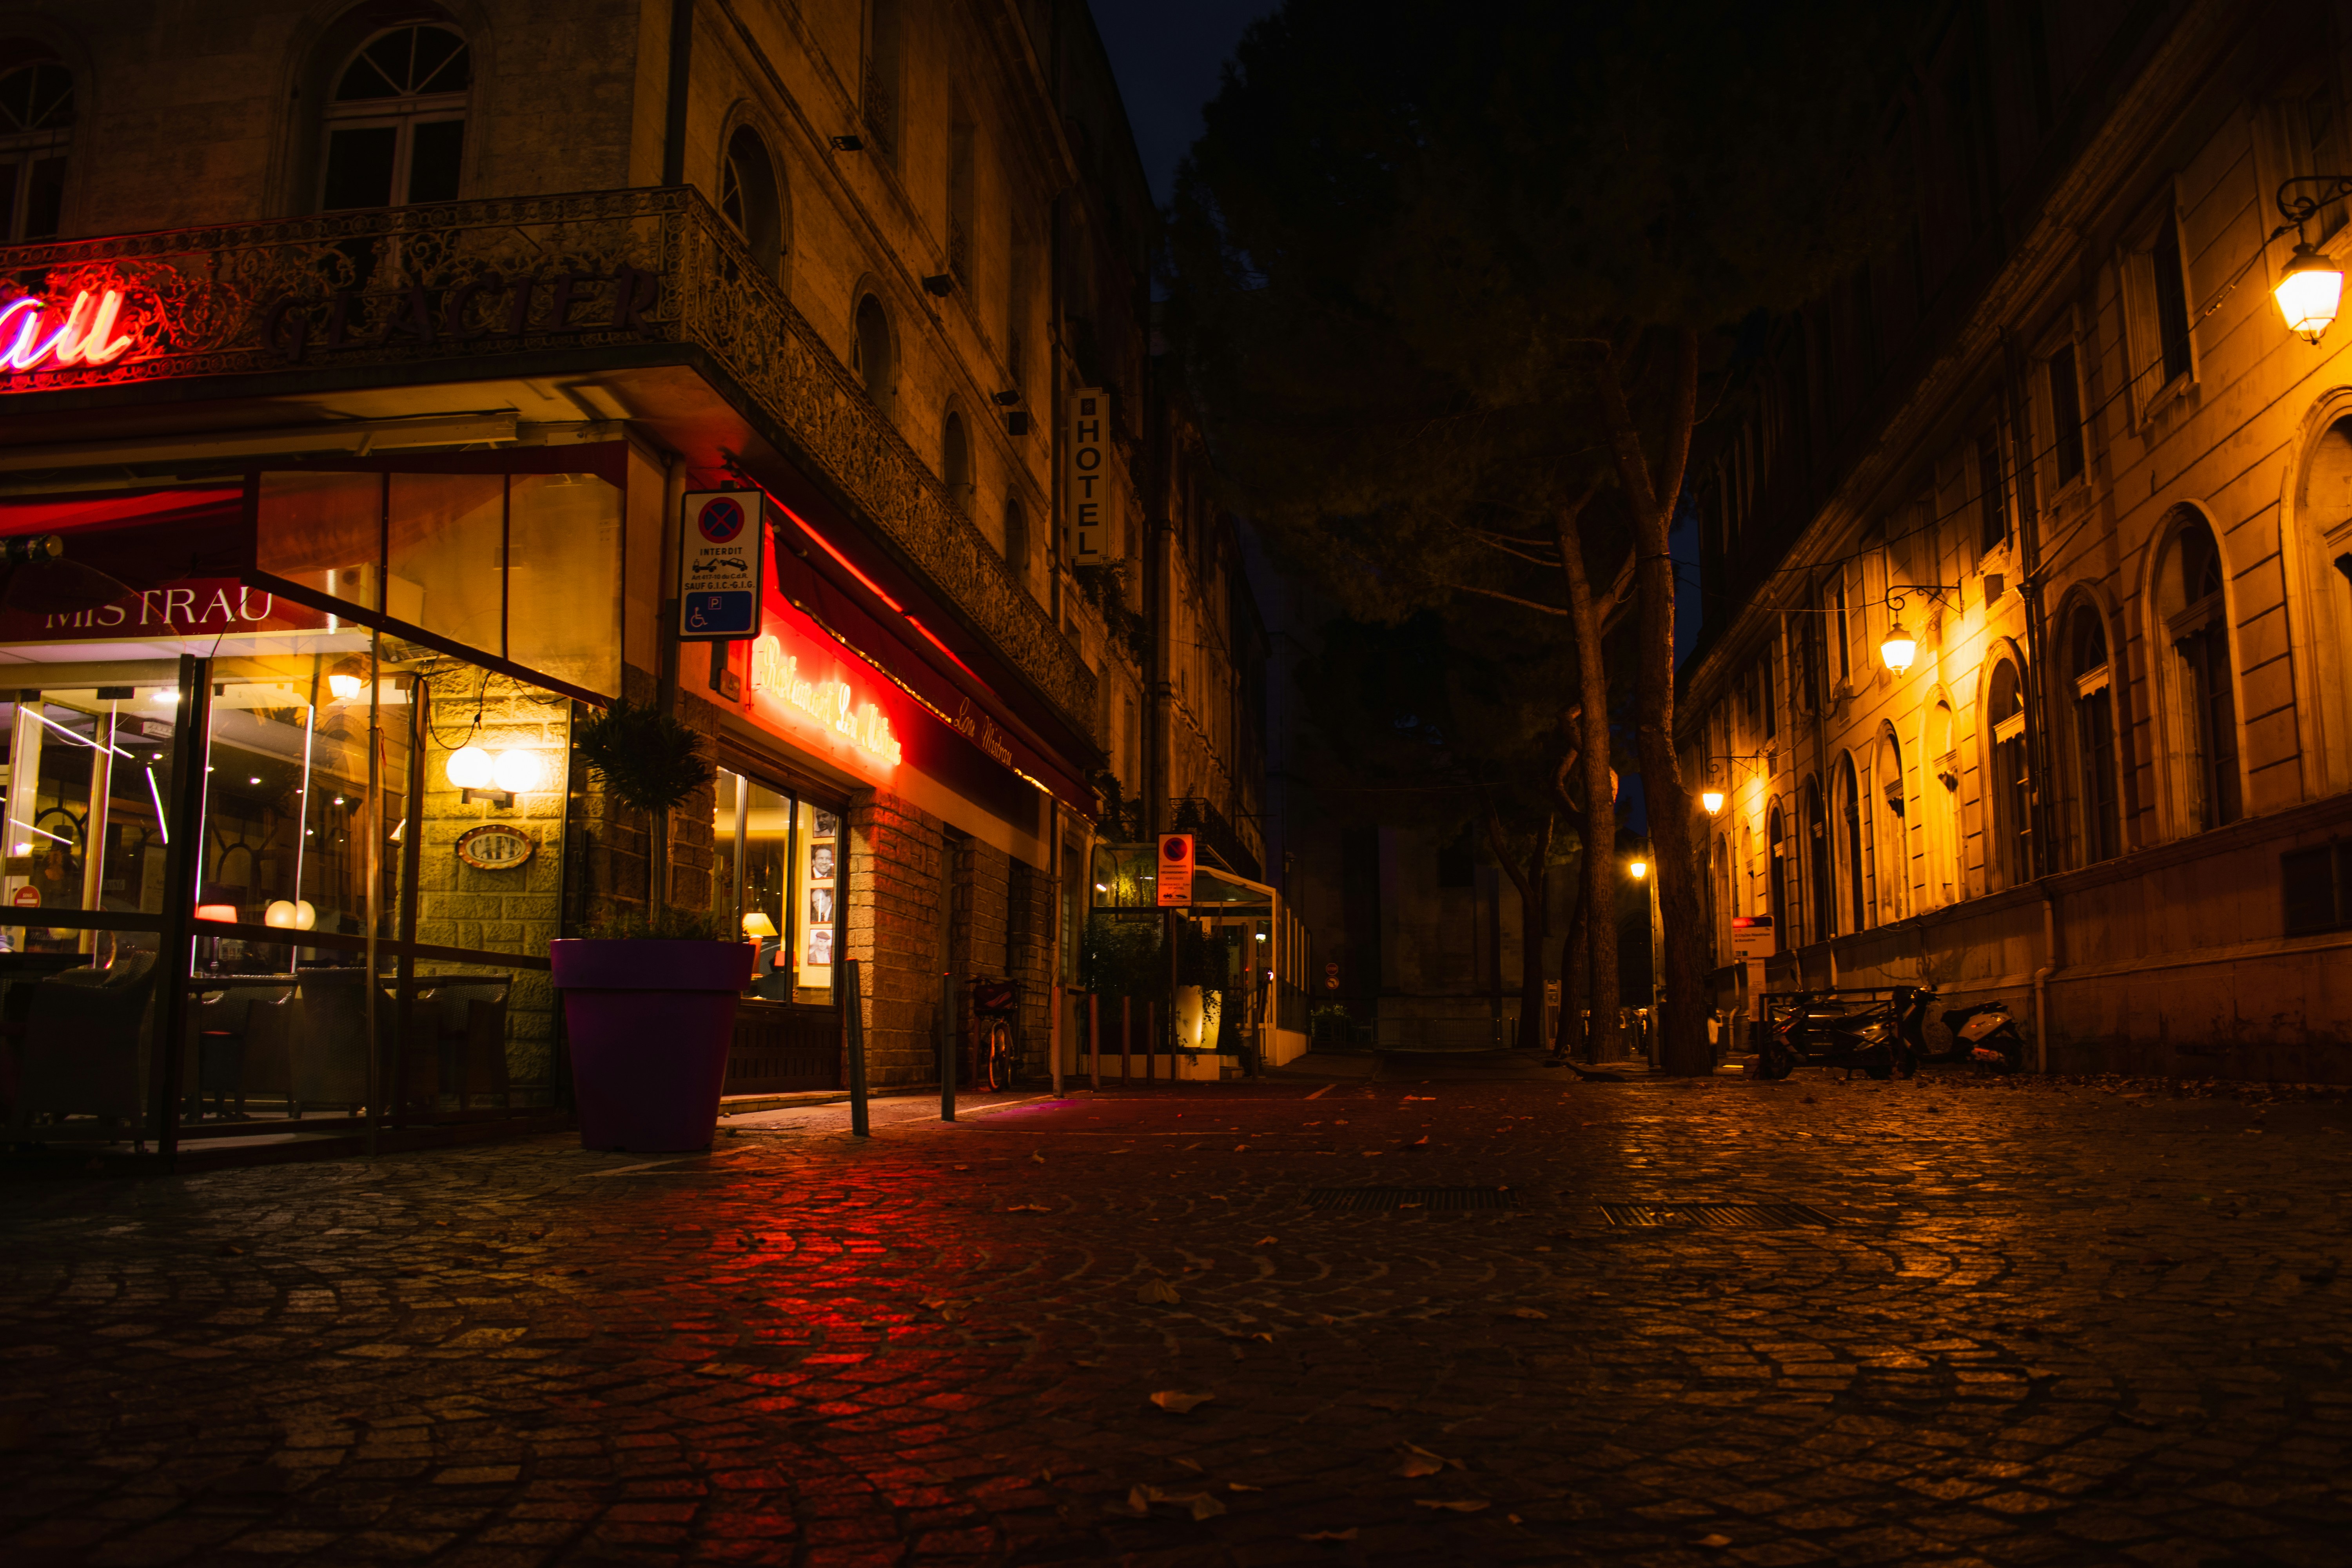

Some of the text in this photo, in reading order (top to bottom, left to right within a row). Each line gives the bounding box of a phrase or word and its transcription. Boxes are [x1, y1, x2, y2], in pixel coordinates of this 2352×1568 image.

[262, 268, 659, 362] GLACIER
[1075, 419, 1101, 555] HOTEL
[700, 547, 742, 556] INTERDIT
[953, 697, 1012, 766] Lou Mistrau
